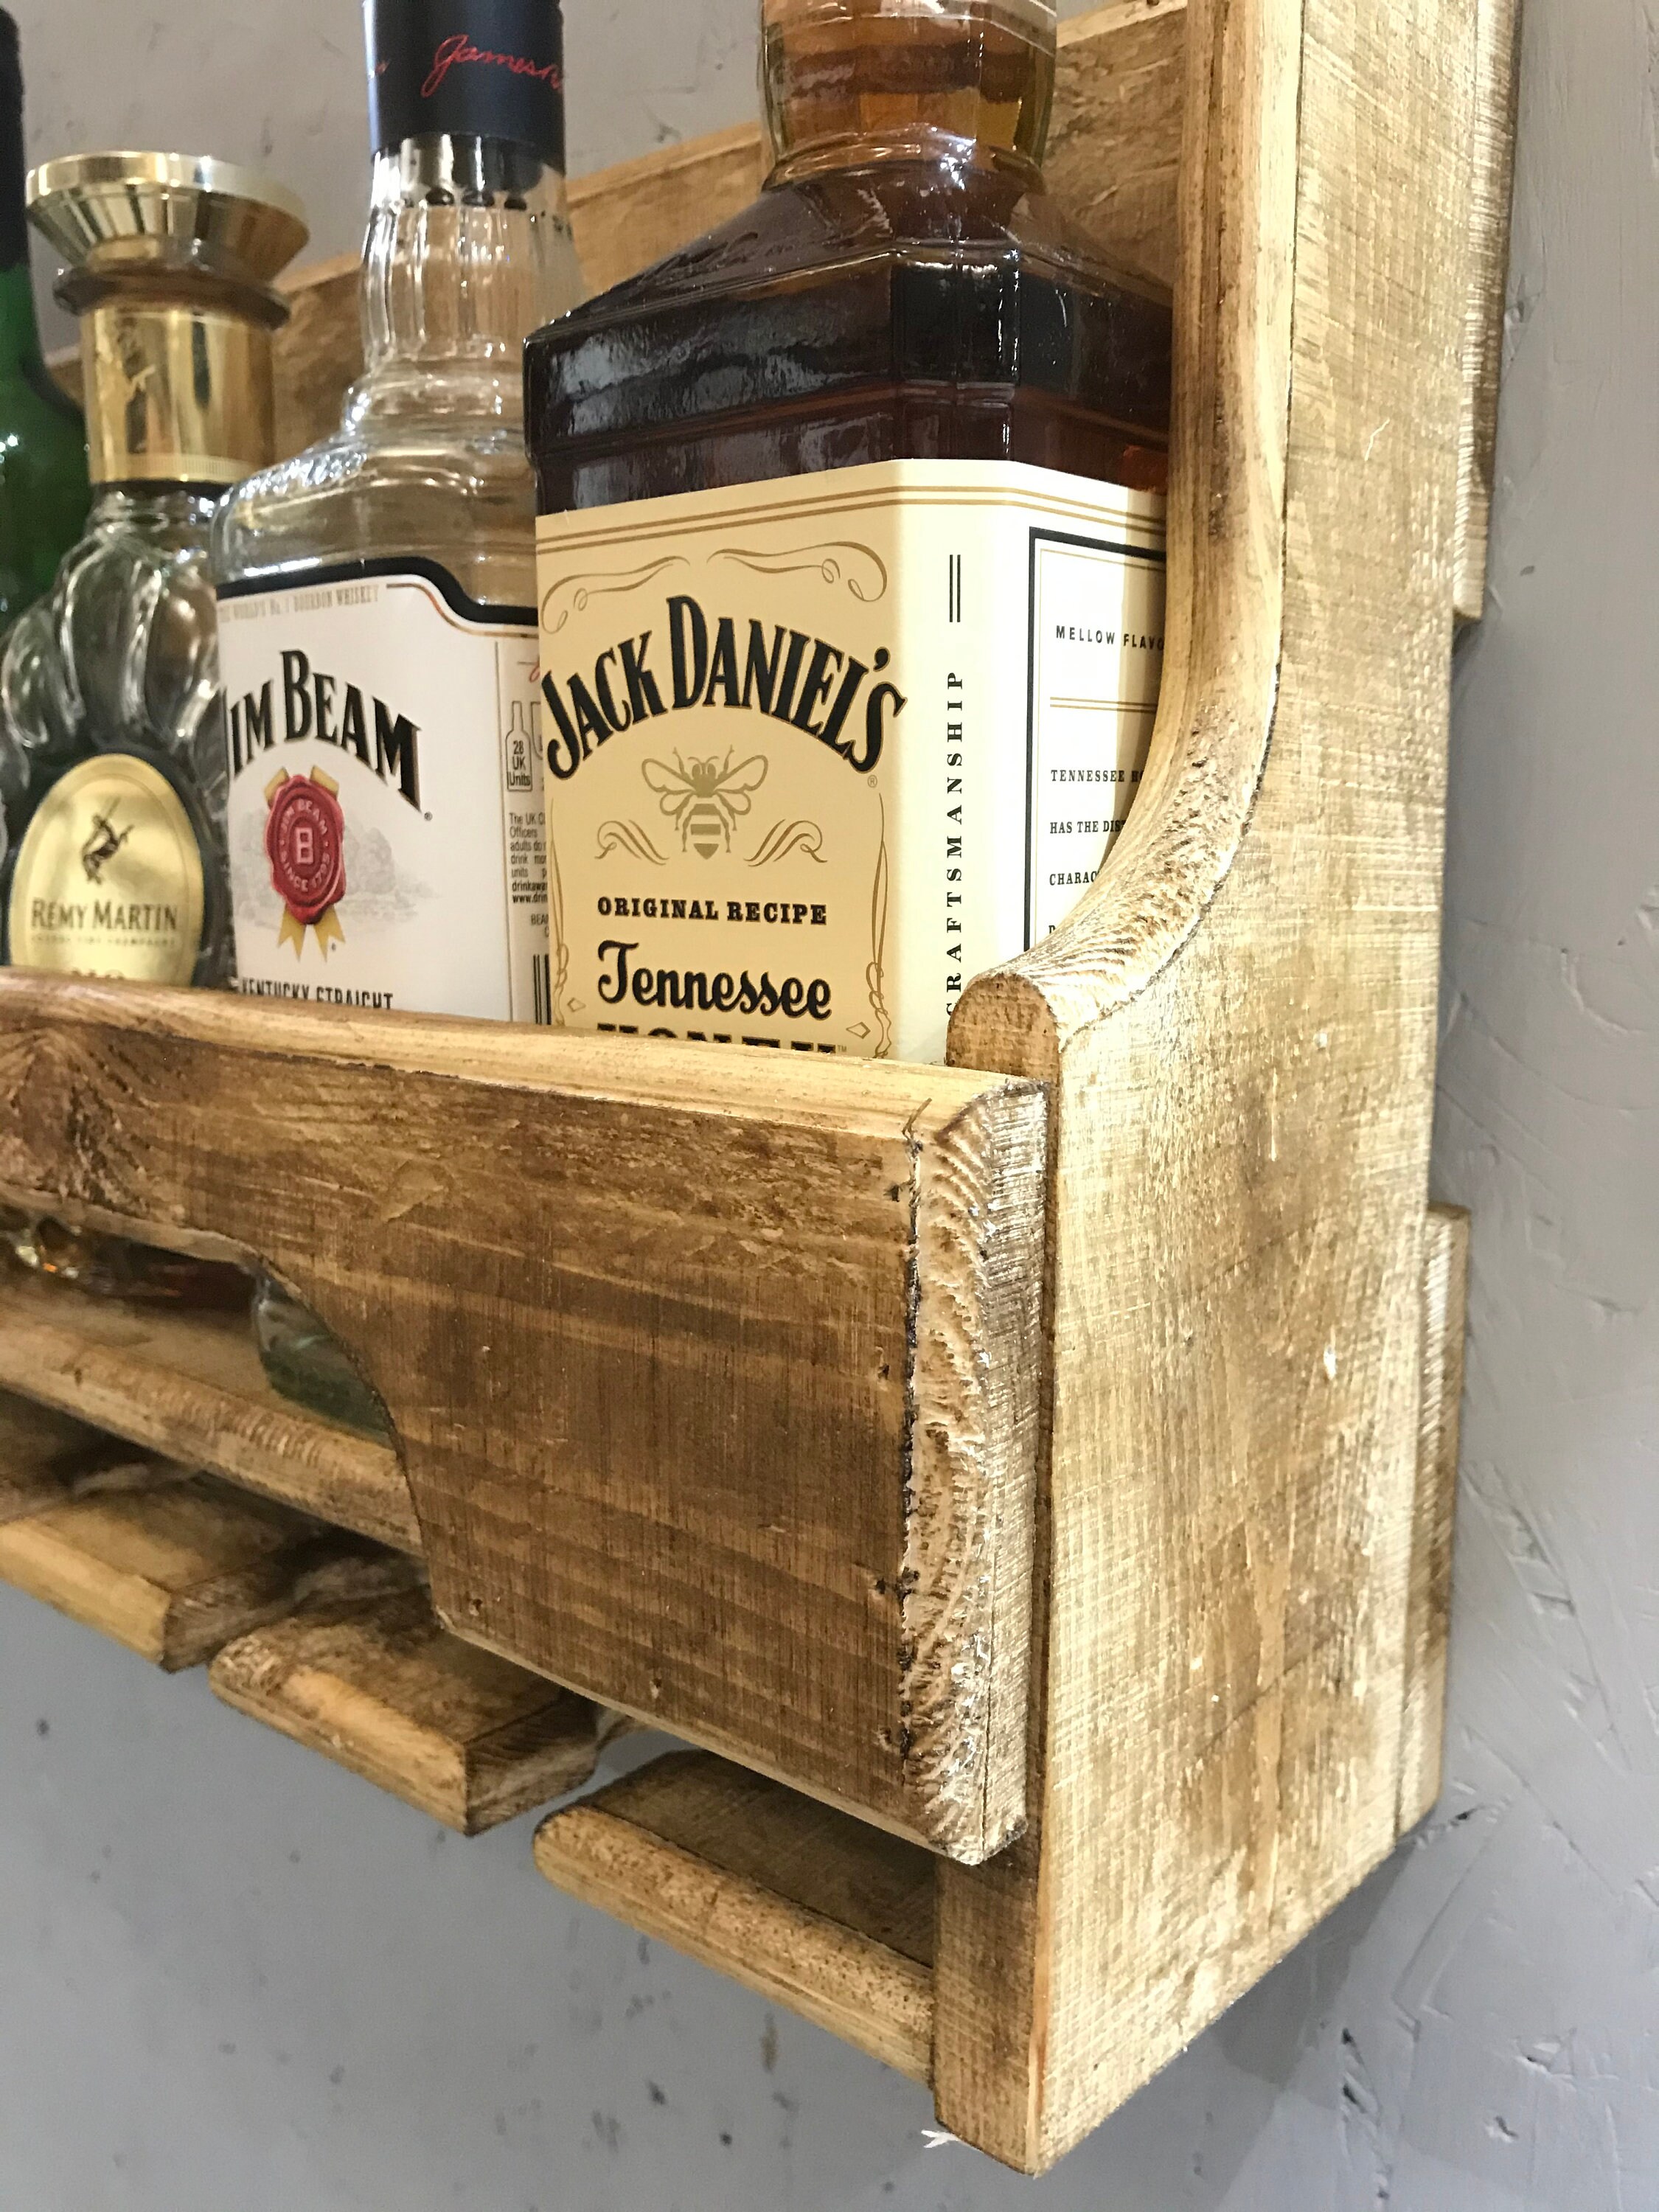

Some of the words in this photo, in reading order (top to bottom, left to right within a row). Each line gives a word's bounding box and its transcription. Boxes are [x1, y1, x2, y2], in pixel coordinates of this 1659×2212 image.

[1056, 625, 1115, 644] MELLOW
[541, 630, 668, 780] JACK
[666, 594, 908, 774] DANIEL'S
[279, 648, 422, 813] BEAM
[513, 740, 524, 754] 28
[512, 757, 526, 770] UK
[509, 771, 531, 786] Units
[1051, 770, 1124, 782] TENNESSEE
[1050, 821, 1073, 833] HAS
[1077, 821, 1099, 832] THE
[296, 827, 314, 864] B
[92, 899, 178, 931] MARTIN
[597, 896, 719, 920] ORIGINAL
[727, 901, 827, 925] RECIPE
[597, 939, 832, 1020] Tennessee
